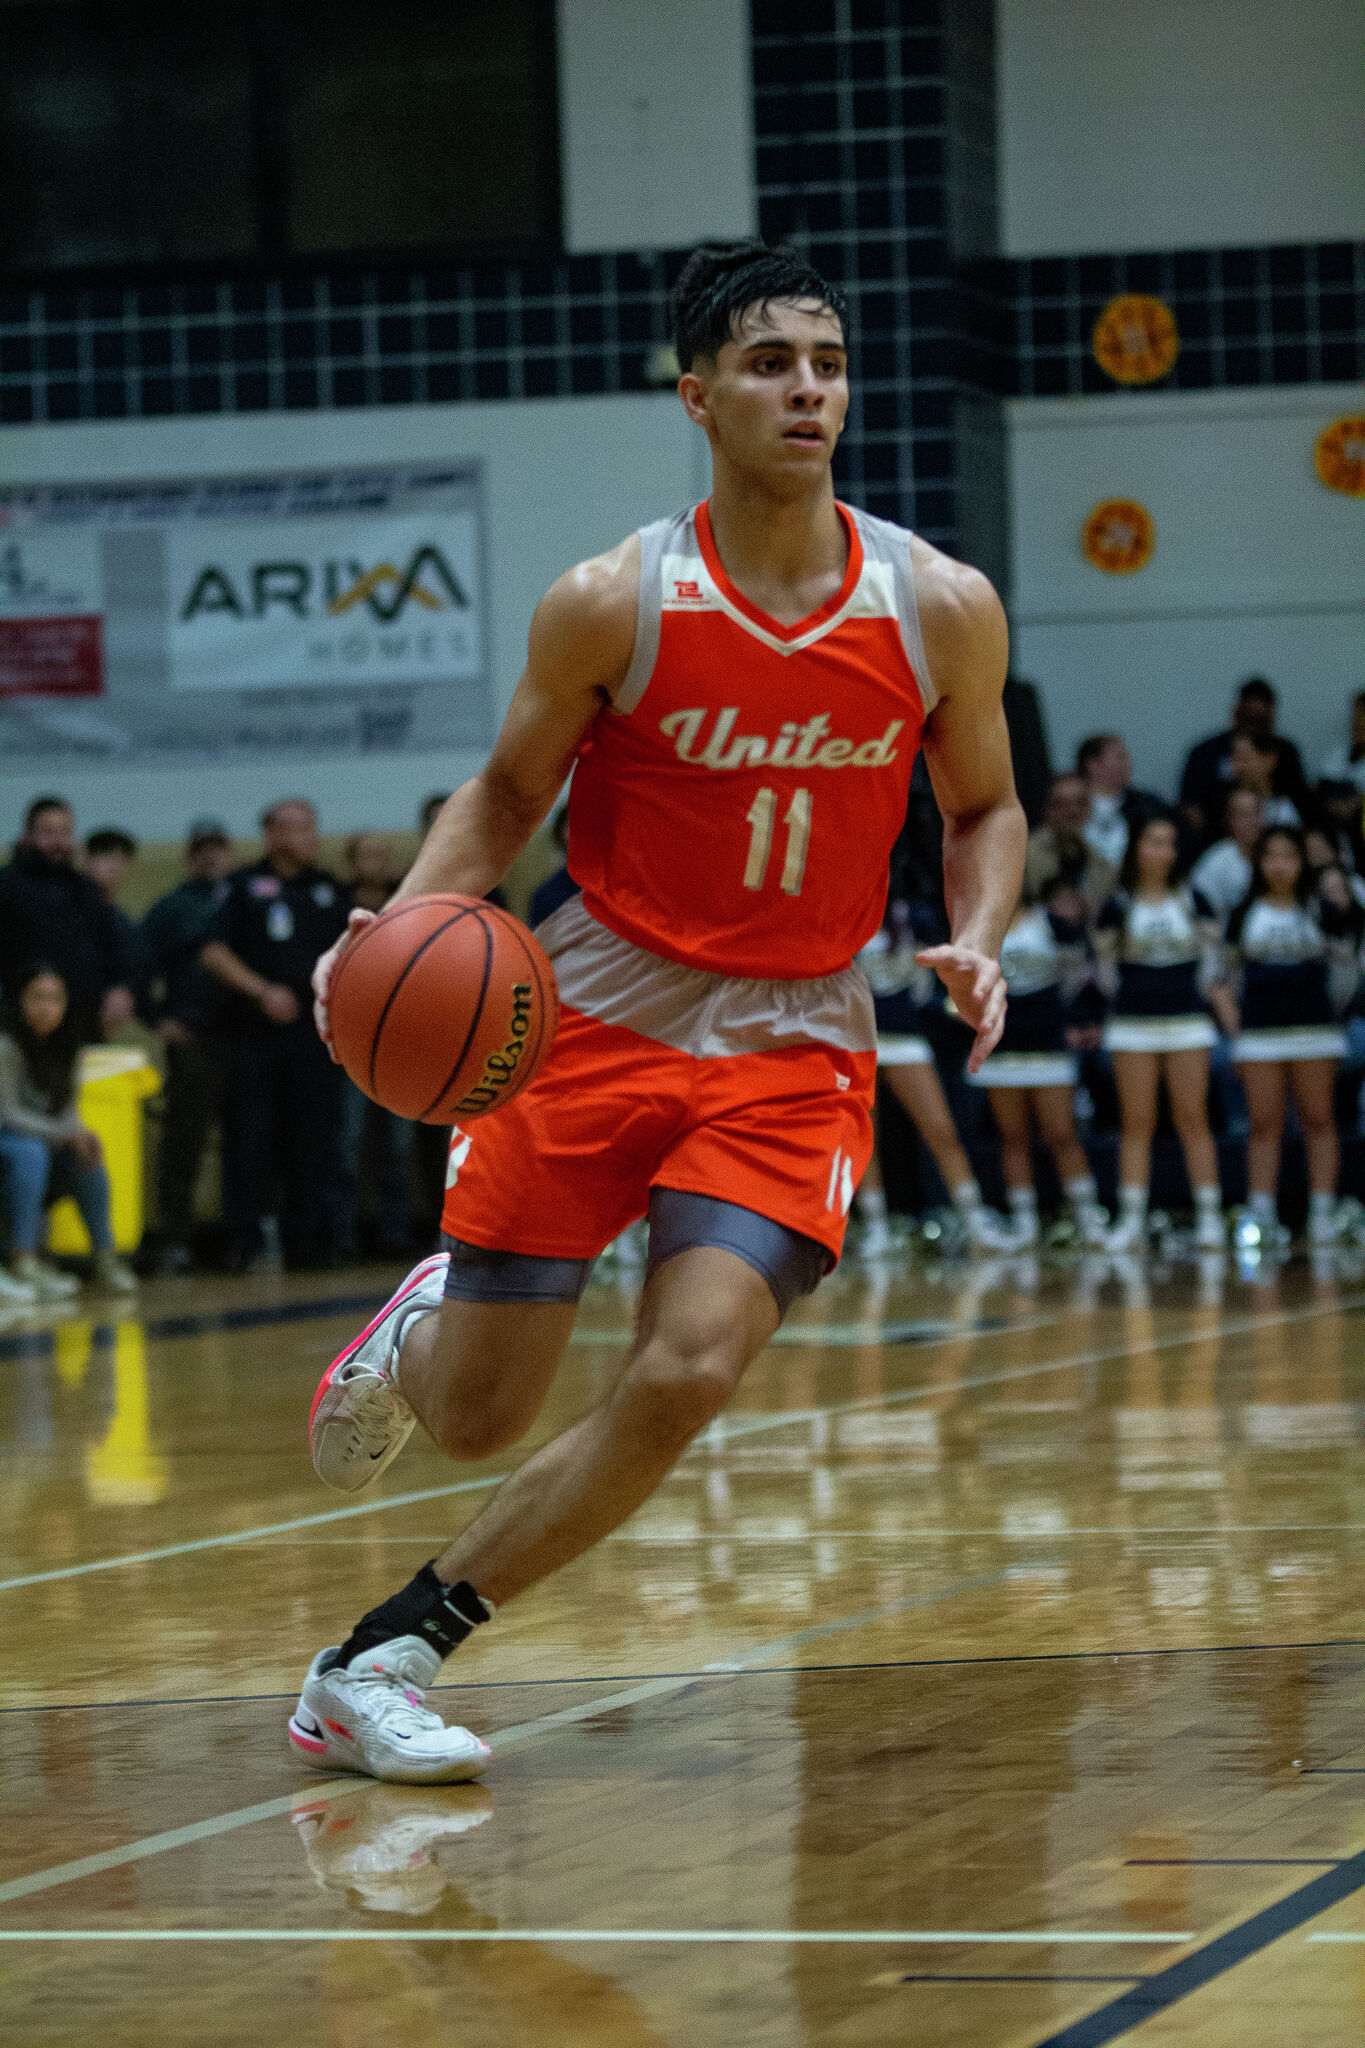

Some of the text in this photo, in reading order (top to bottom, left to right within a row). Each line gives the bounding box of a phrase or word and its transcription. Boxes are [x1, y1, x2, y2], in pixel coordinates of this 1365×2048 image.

[178, 541, 470, 625] ARIXA
[659, 706, 905, 770] United
[743, 787, 814, 896] 11
[450, 983, 532, 1113] Wilson
